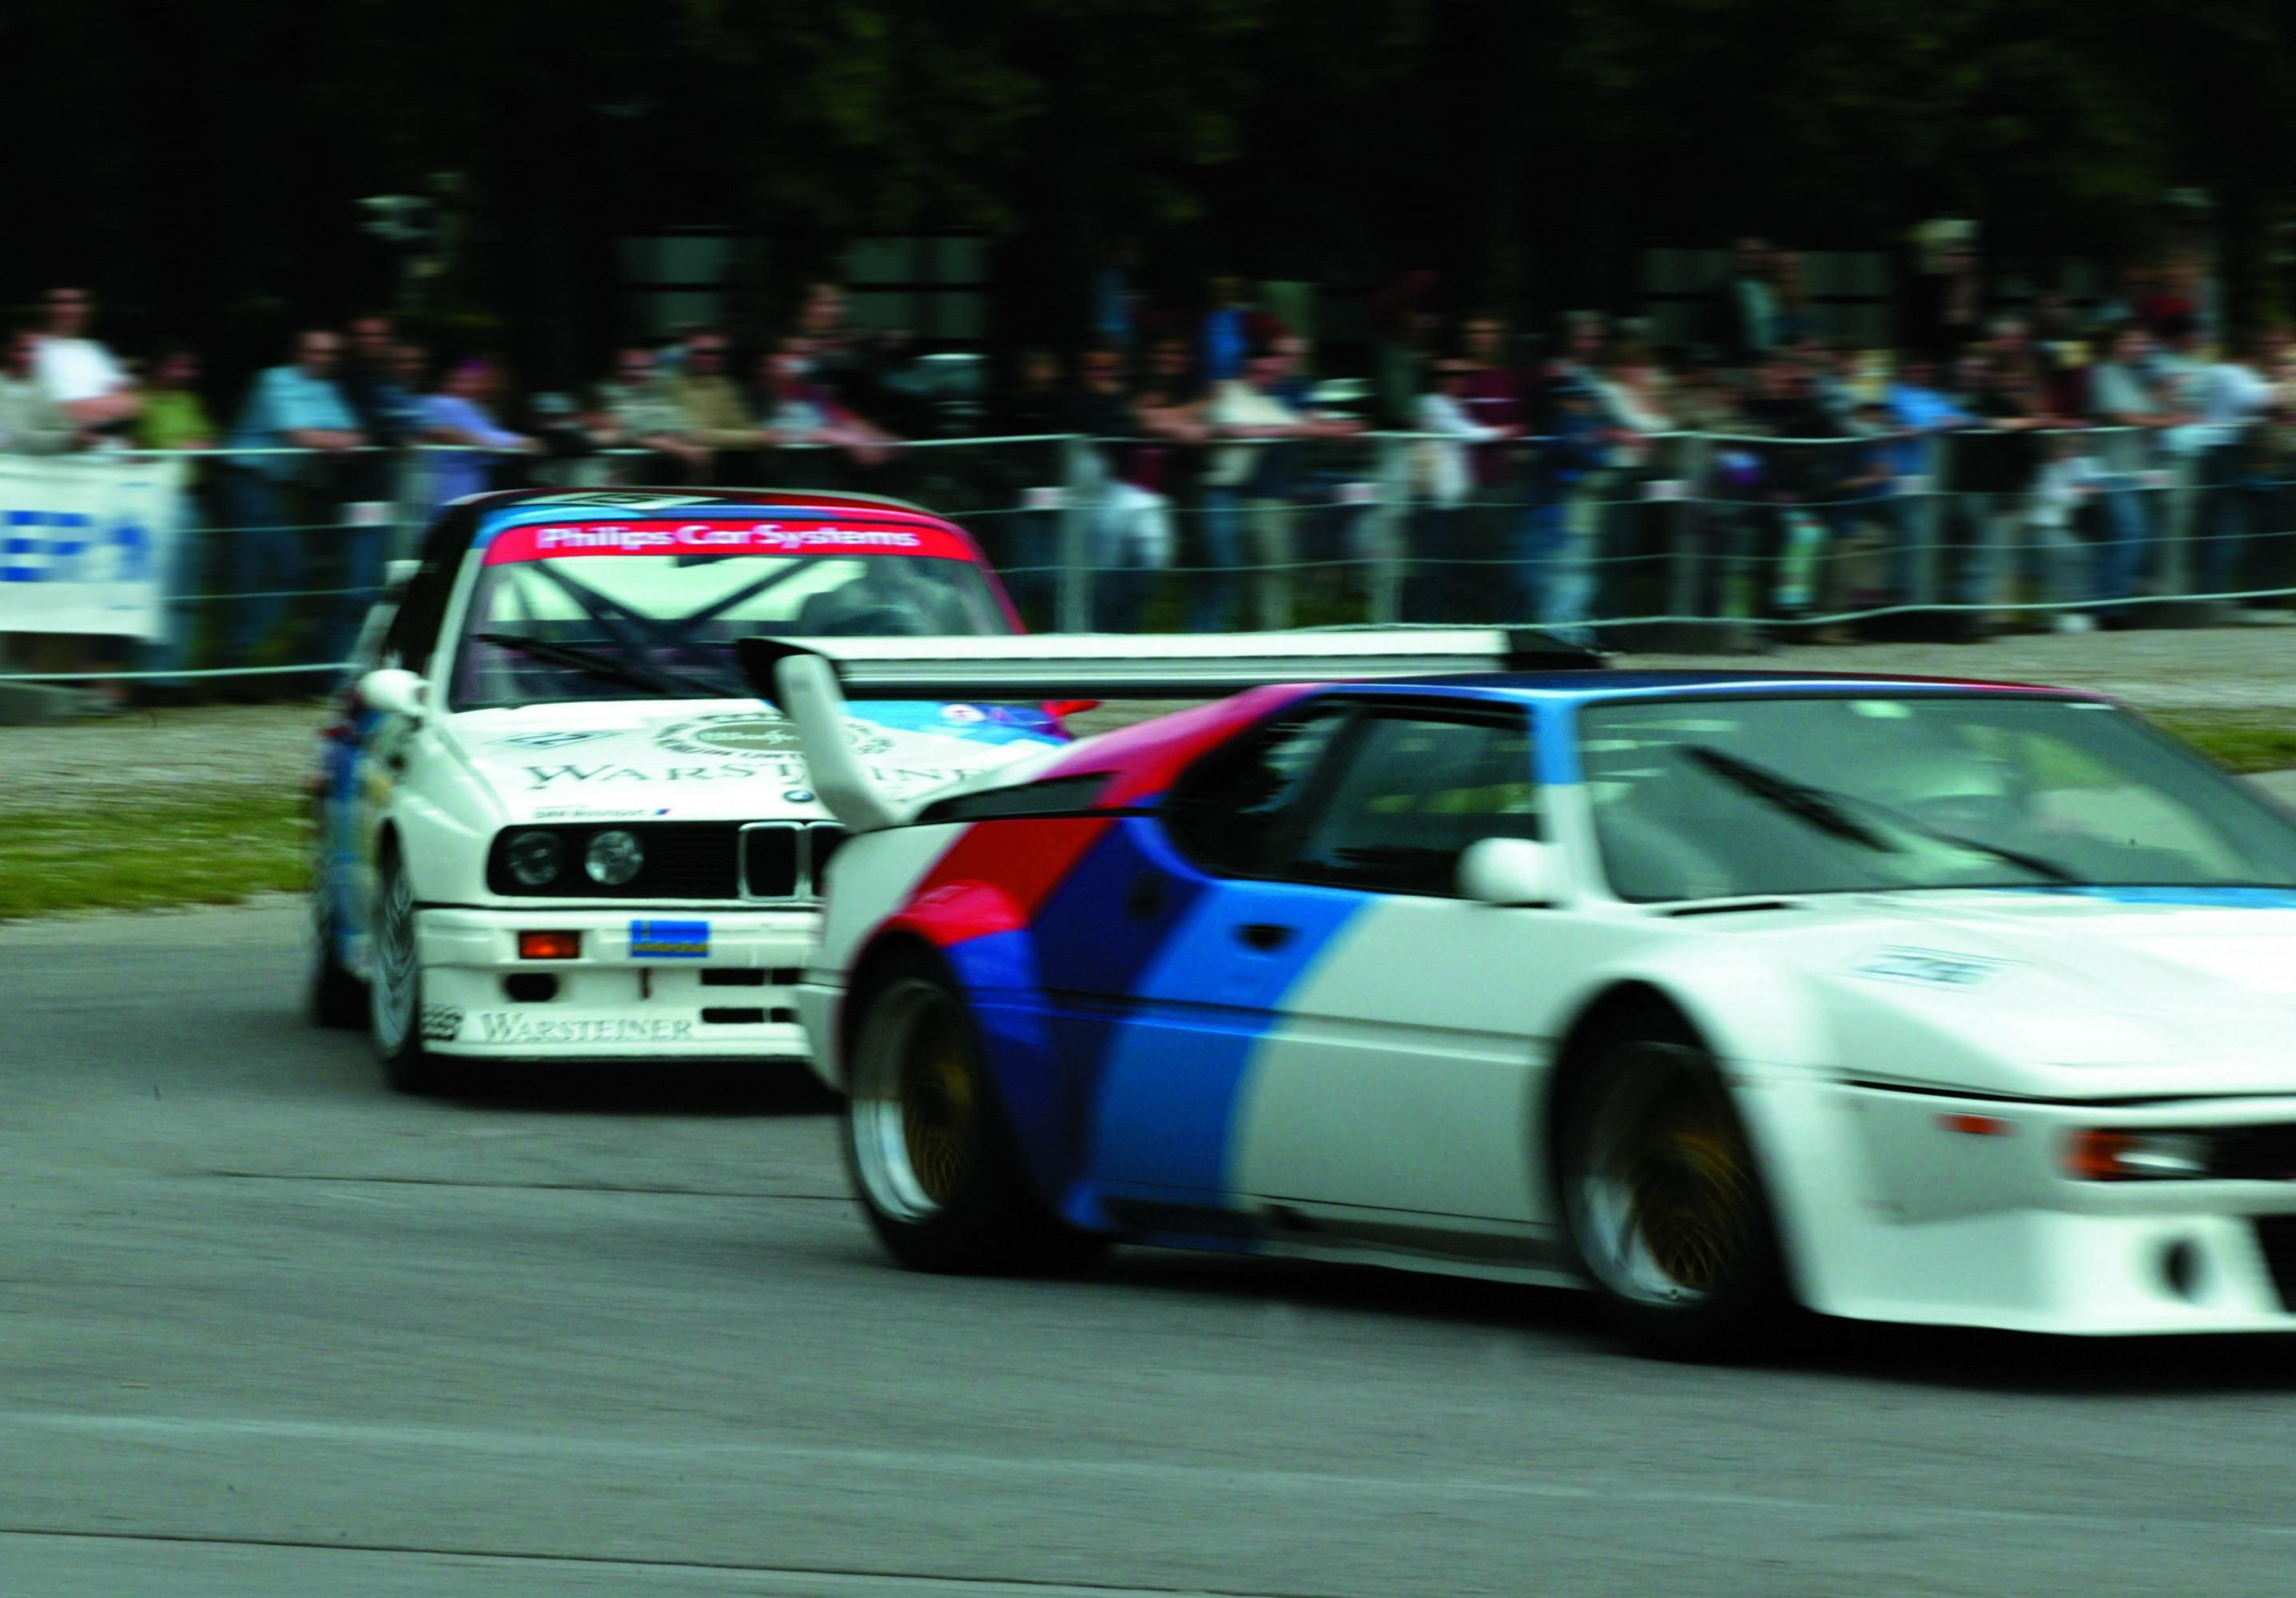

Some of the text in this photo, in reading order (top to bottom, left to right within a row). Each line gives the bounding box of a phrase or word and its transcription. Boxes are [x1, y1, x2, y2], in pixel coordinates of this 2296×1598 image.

[535, 524, 921, 551] Philips Car Systems
